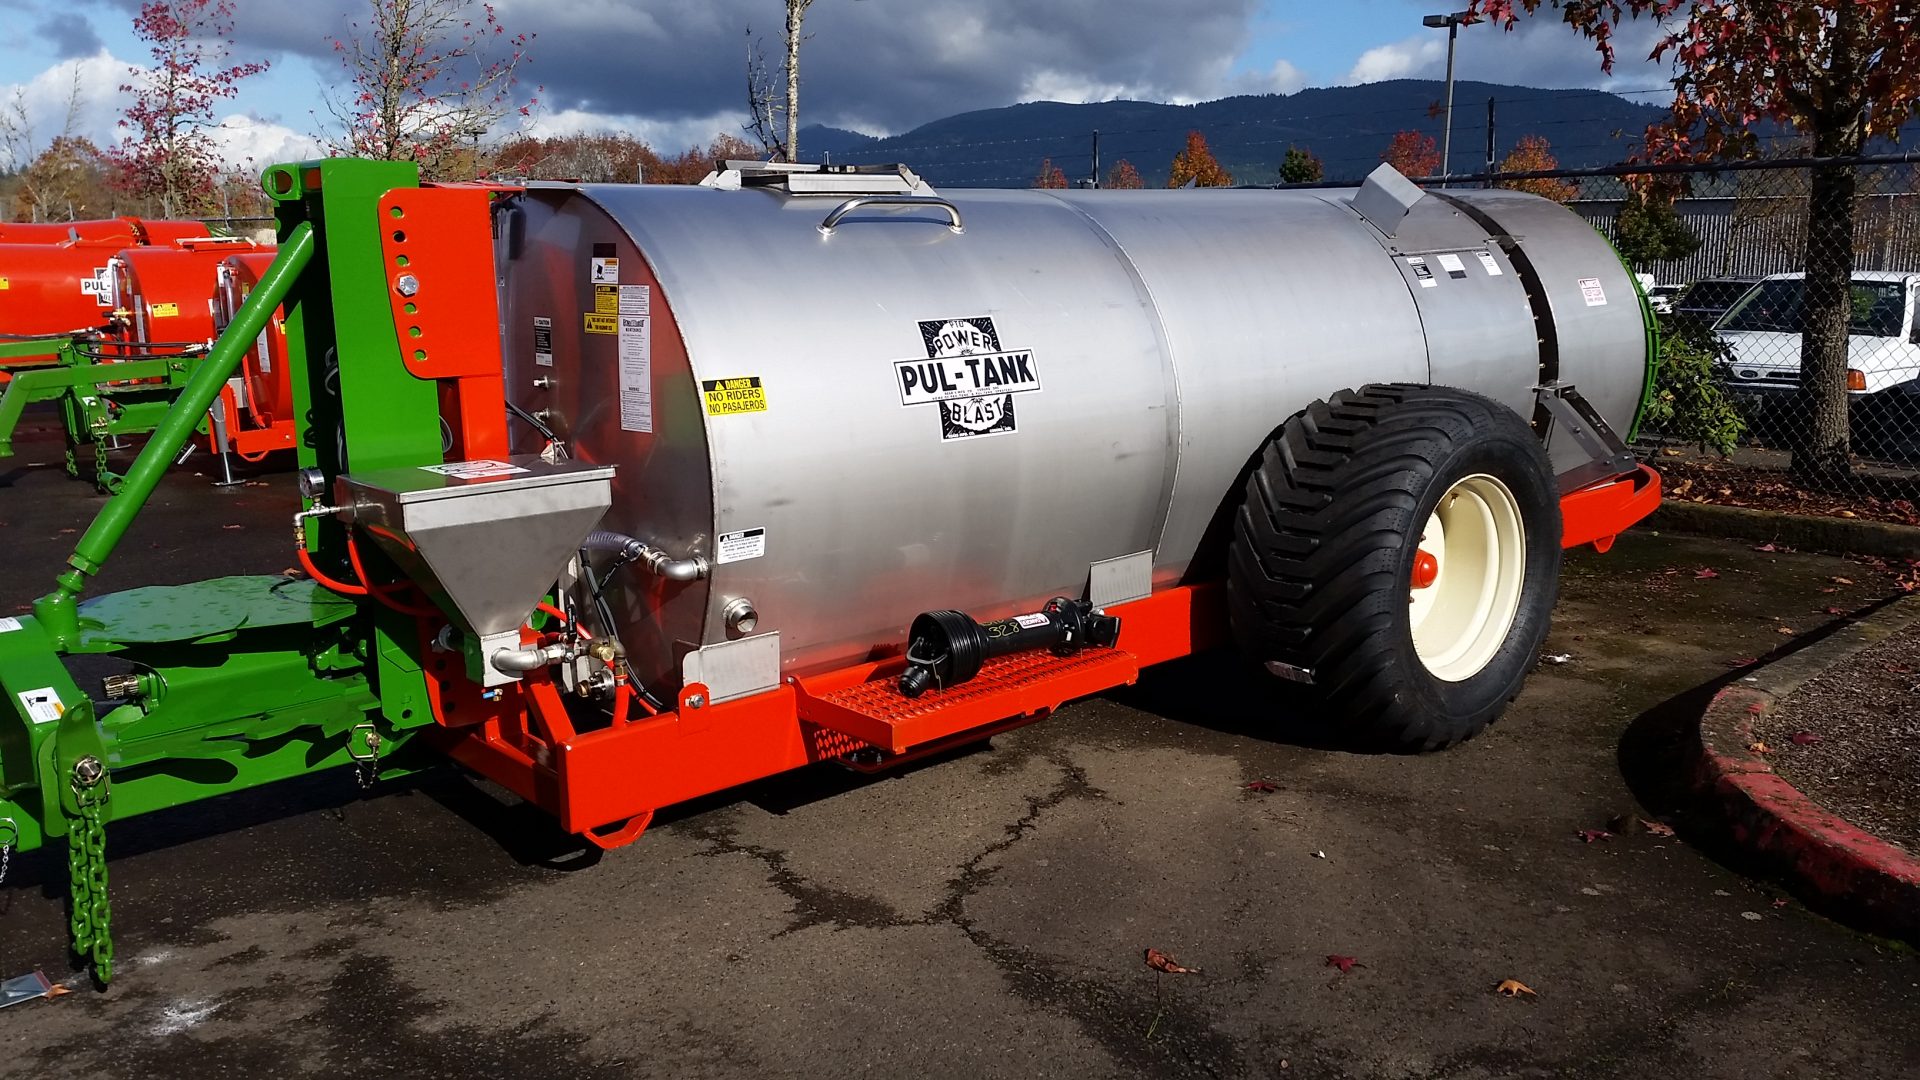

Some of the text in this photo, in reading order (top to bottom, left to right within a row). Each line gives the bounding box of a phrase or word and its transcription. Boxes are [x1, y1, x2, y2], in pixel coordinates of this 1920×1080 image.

[84, 281, 111, 291] PUL-
[934, 329, 992, 356] POWER
[899, 353, 1036, 396] PUL-TANK
[725, 379, 752, 390] DANGER
[708, 388, 761, 402] NO RIDERS
[708, 399, 765, 413] NO PASAJEROS
[951, 396, 1004, 424] BLAST
[988, 621, 1020, 638] 328
